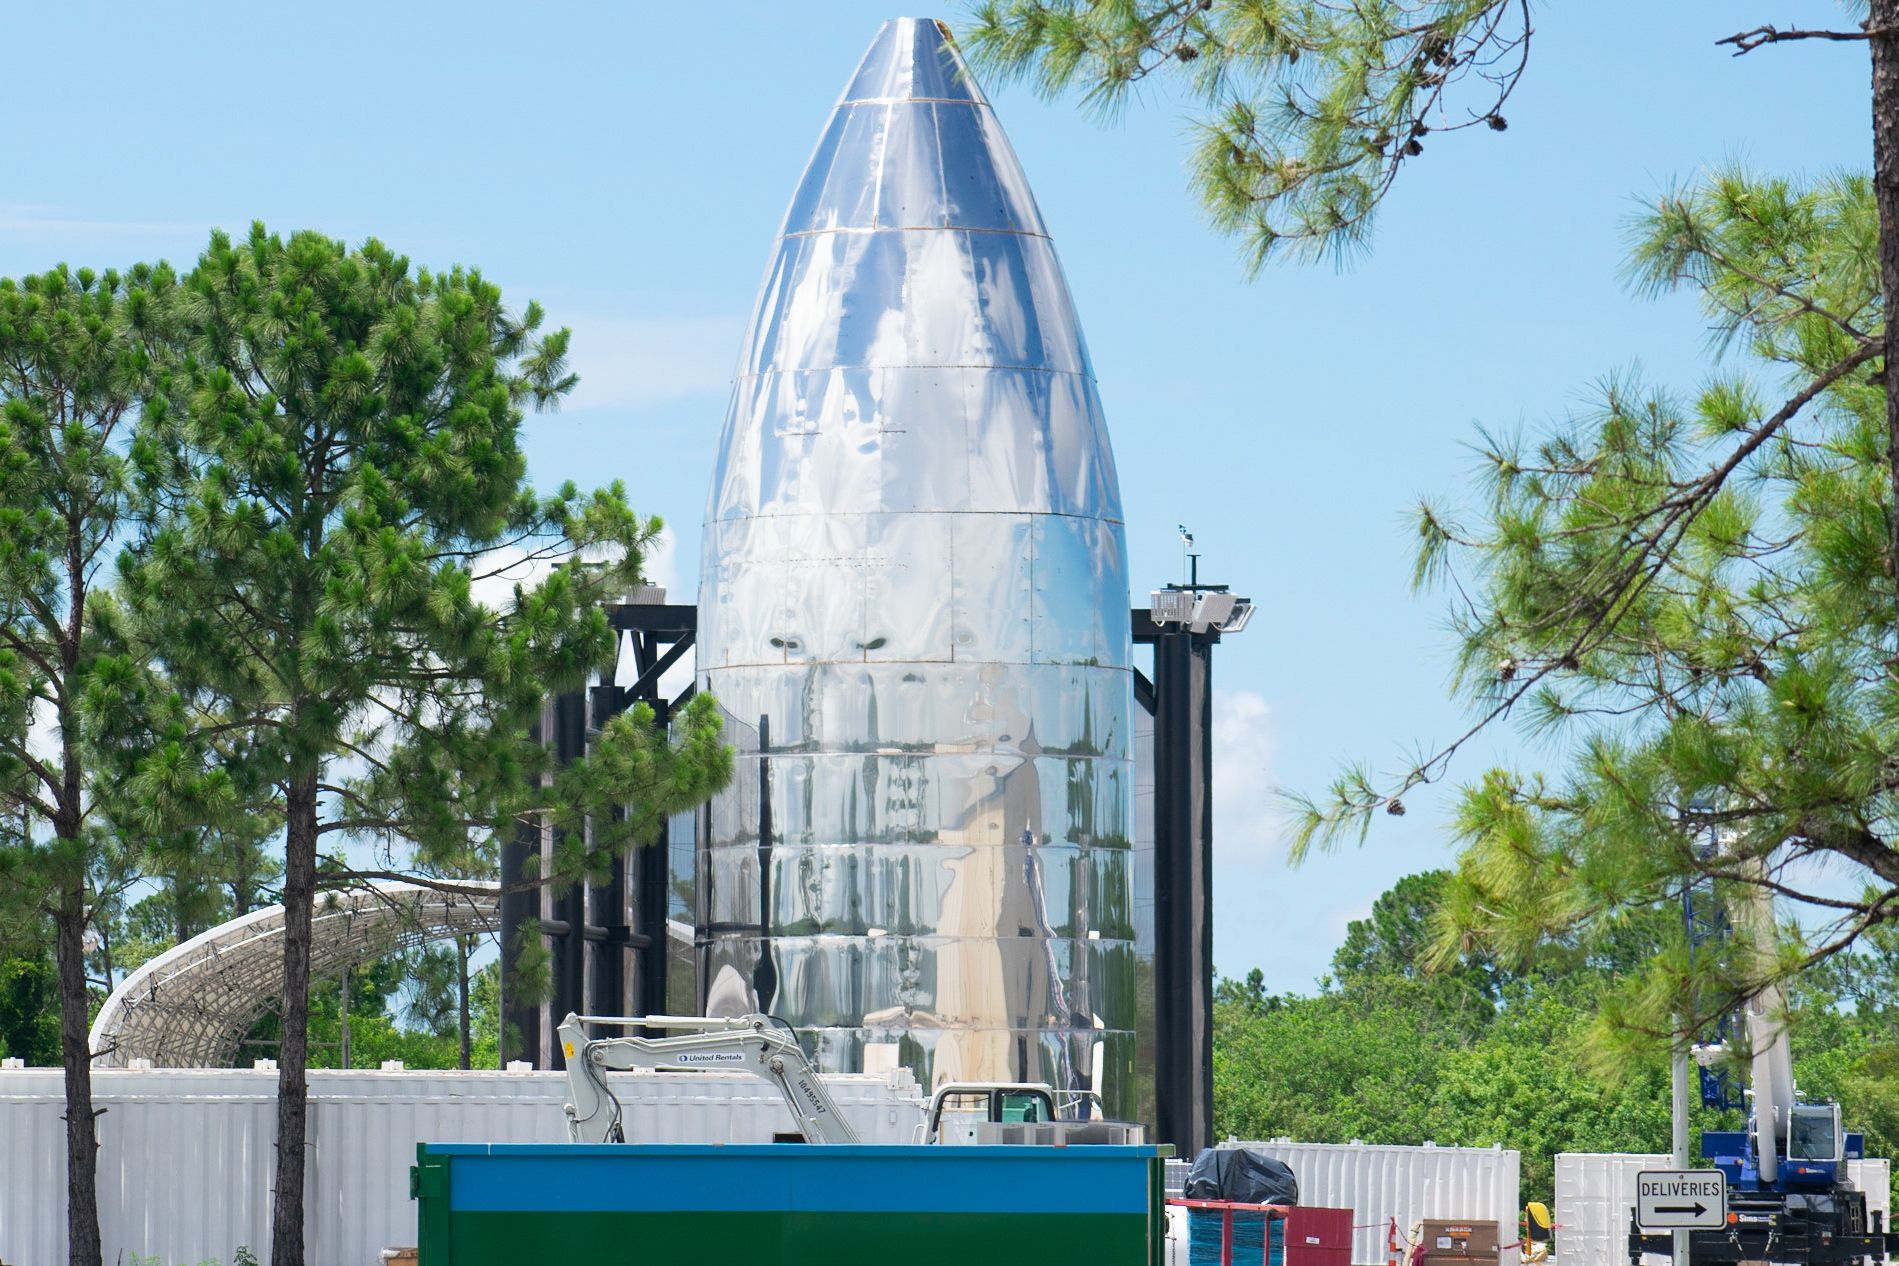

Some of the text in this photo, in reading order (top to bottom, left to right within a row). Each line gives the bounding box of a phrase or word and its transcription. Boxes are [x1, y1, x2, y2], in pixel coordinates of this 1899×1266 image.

[689, 1053, 742, 1062] United Rentals
[798, 1079, 826, 1114] 10495547
[1642, 1182, 1720, 1196] DELIVERIES
